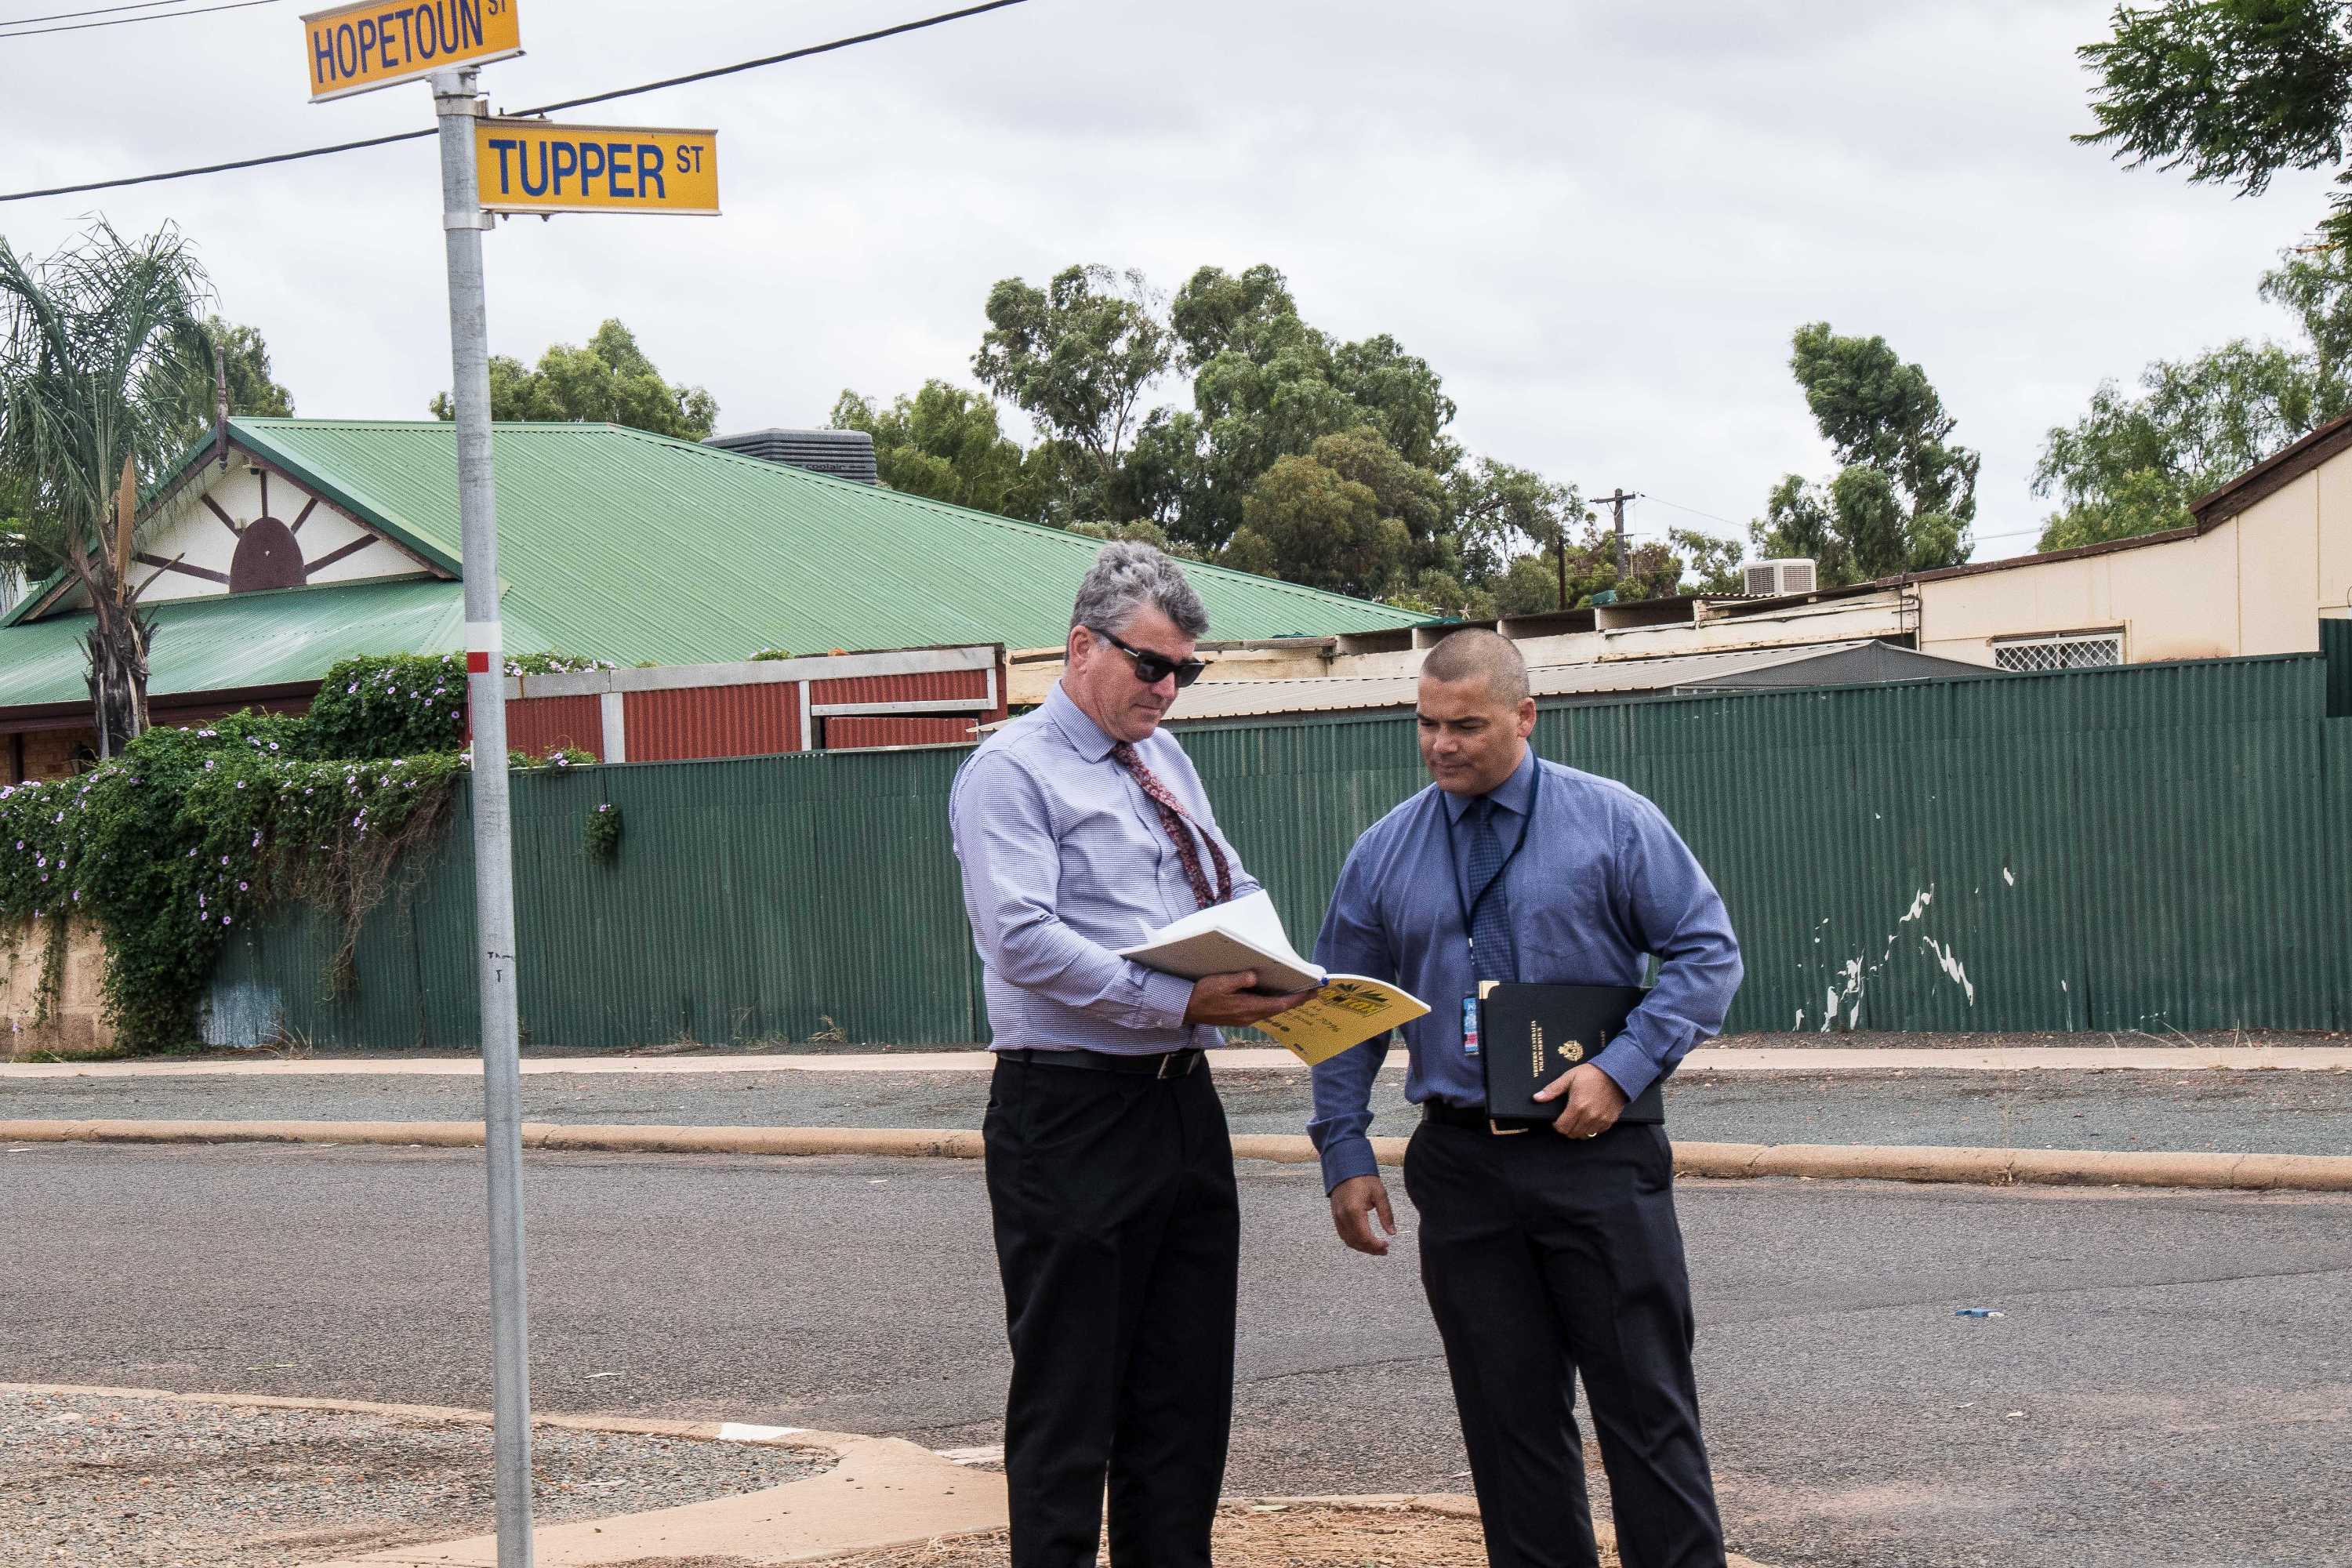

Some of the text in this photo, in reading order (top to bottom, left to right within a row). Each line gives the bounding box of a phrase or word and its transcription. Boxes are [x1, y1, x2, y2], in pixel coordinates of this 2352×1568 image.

[314, 0, 484, 83] HOPETOUN
[488, 139, 704, 198] TUPPER ST
